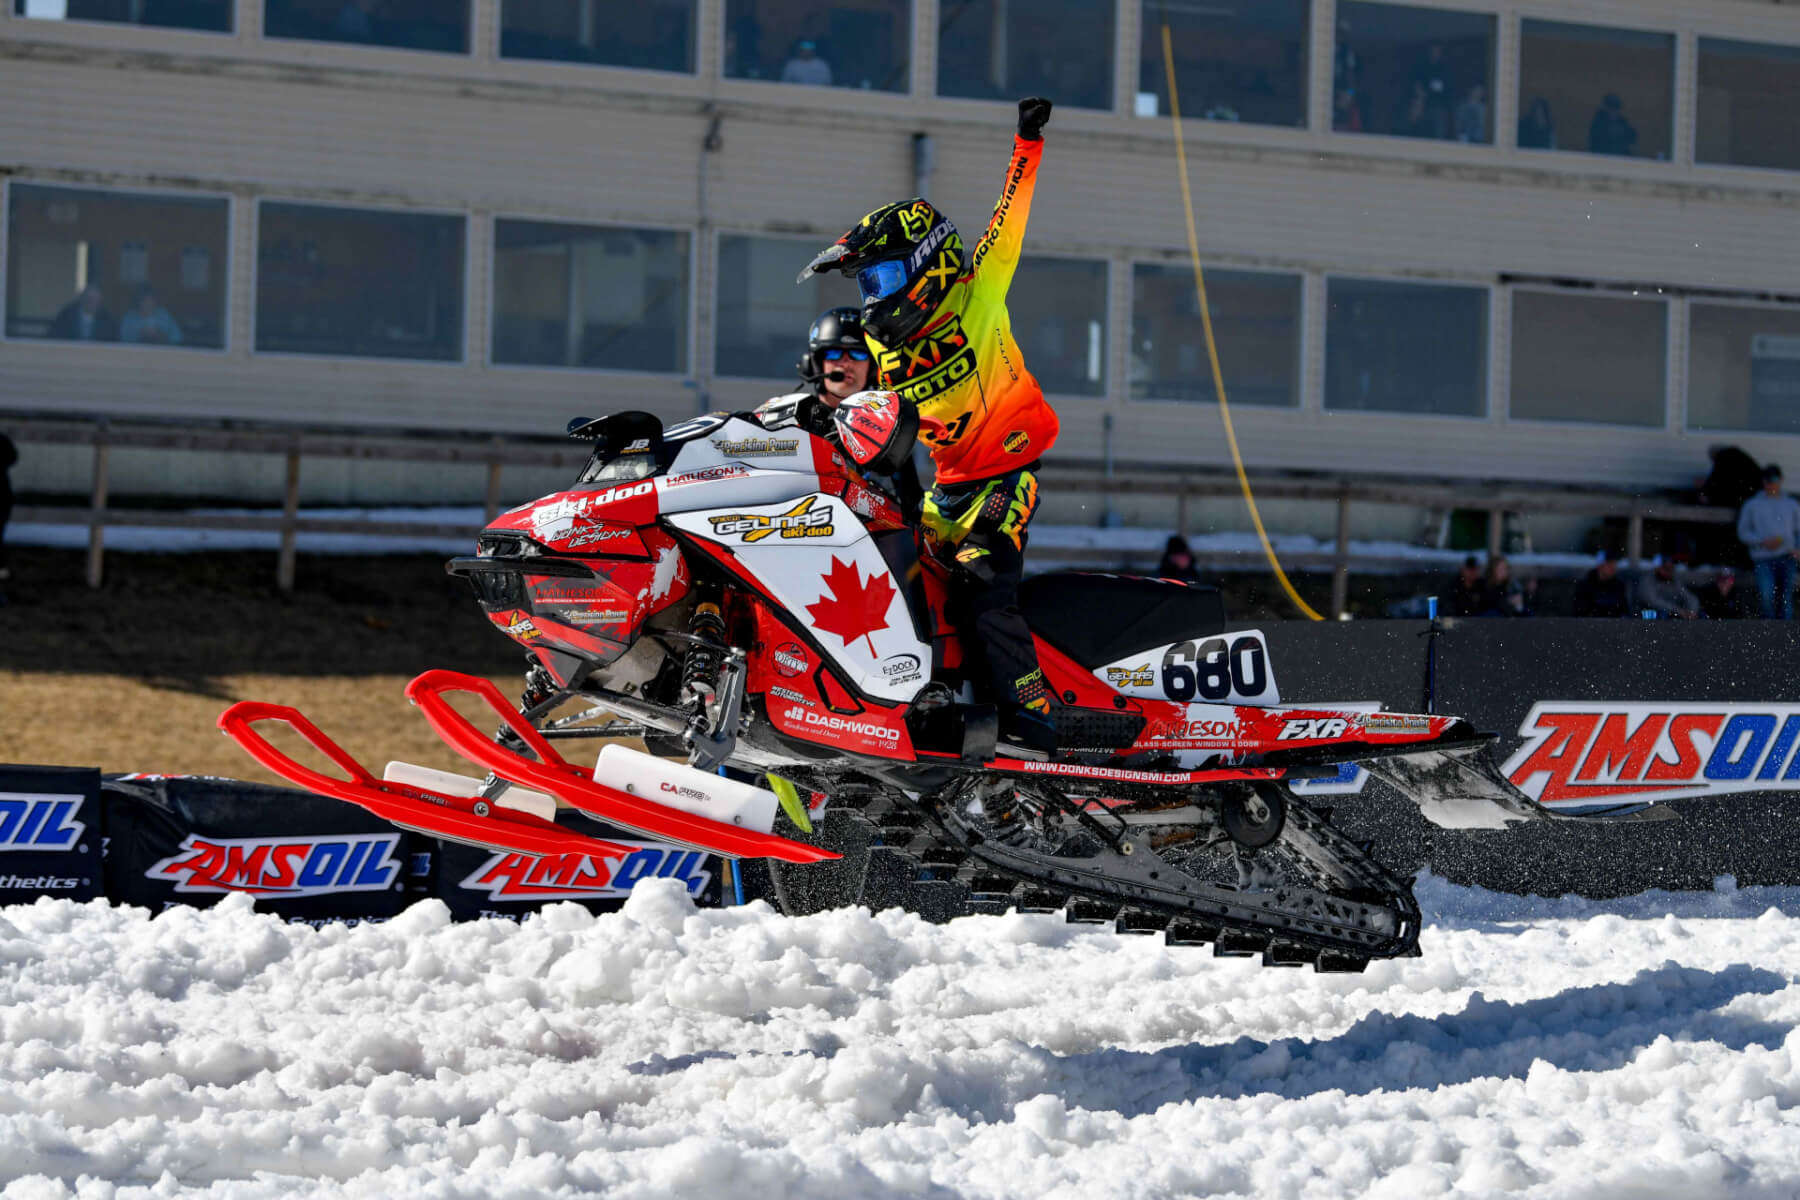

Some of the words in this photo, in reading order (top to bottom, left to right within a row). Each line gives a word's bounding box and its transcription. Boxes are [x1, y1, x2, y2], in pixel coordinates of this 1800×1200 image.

[974, 228, 1000, 266] MOTO
[996, 155, 1029, 227] DIVISION
[624, 438, 650, 450] JB
[721, 438, 767, 453] Precision
[768, 437, 799, 451] Power
[781, 524, 834, 539] ski-doo
[1161, 635, 1267, 701] 680
[805, 712, 900, 741] DASHWOOD
[1276, 718, 1349, 741] FXR
[1024, 761, 1191, 783] WWW.DONKSDESIGNSMI.COM
[158, 838, 396, 894] AMSOIL
[474, 849, 706, 896] AMSOIL
